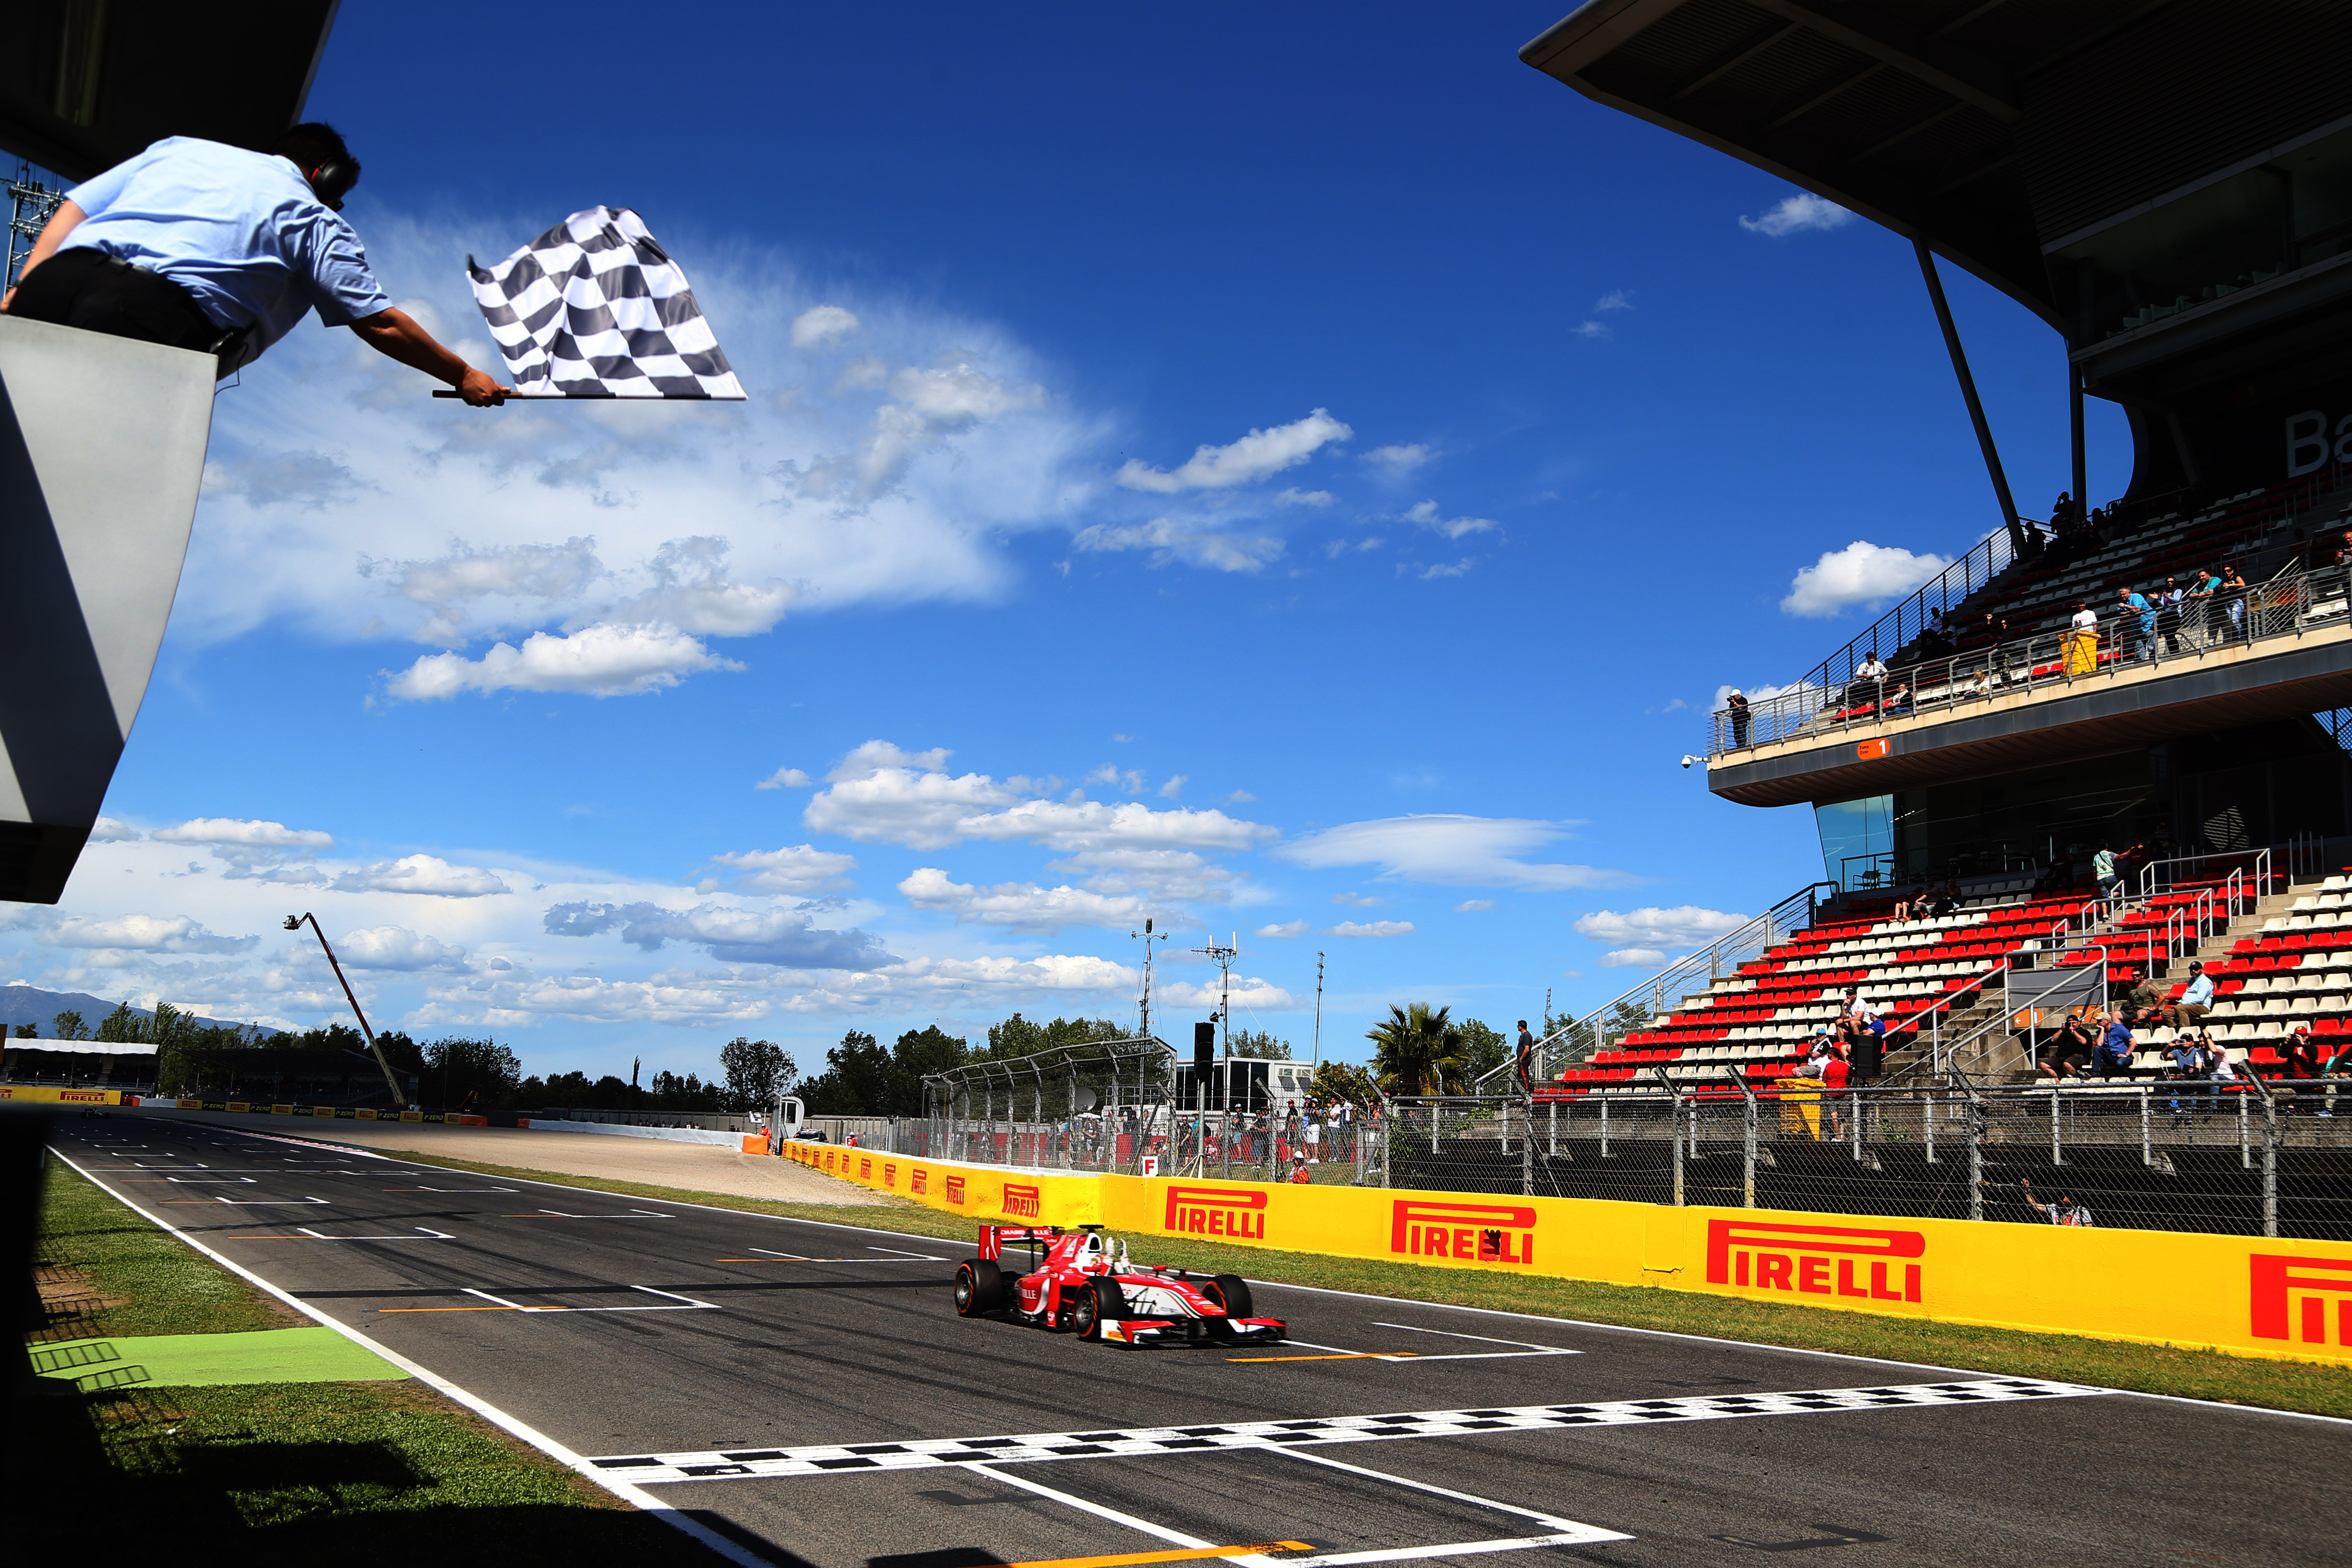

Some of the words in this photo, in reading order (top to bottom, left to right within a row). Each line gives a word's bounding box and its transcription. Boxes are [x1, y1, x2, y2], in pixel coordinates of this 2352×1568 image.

[1879, 740, 1886, 754] 1
[60, 1091, 105, 1101] PIRELLI
[1145, 1160, 1154, 1174] F
[1002, 1183, 1039, 1218] PIRELLI
[1165, 1186, 1267, 1239] PIRELLI
[985, 1246, 989, 1259] 1
[1706, 1219, 1925, 1303] PIRELLI
